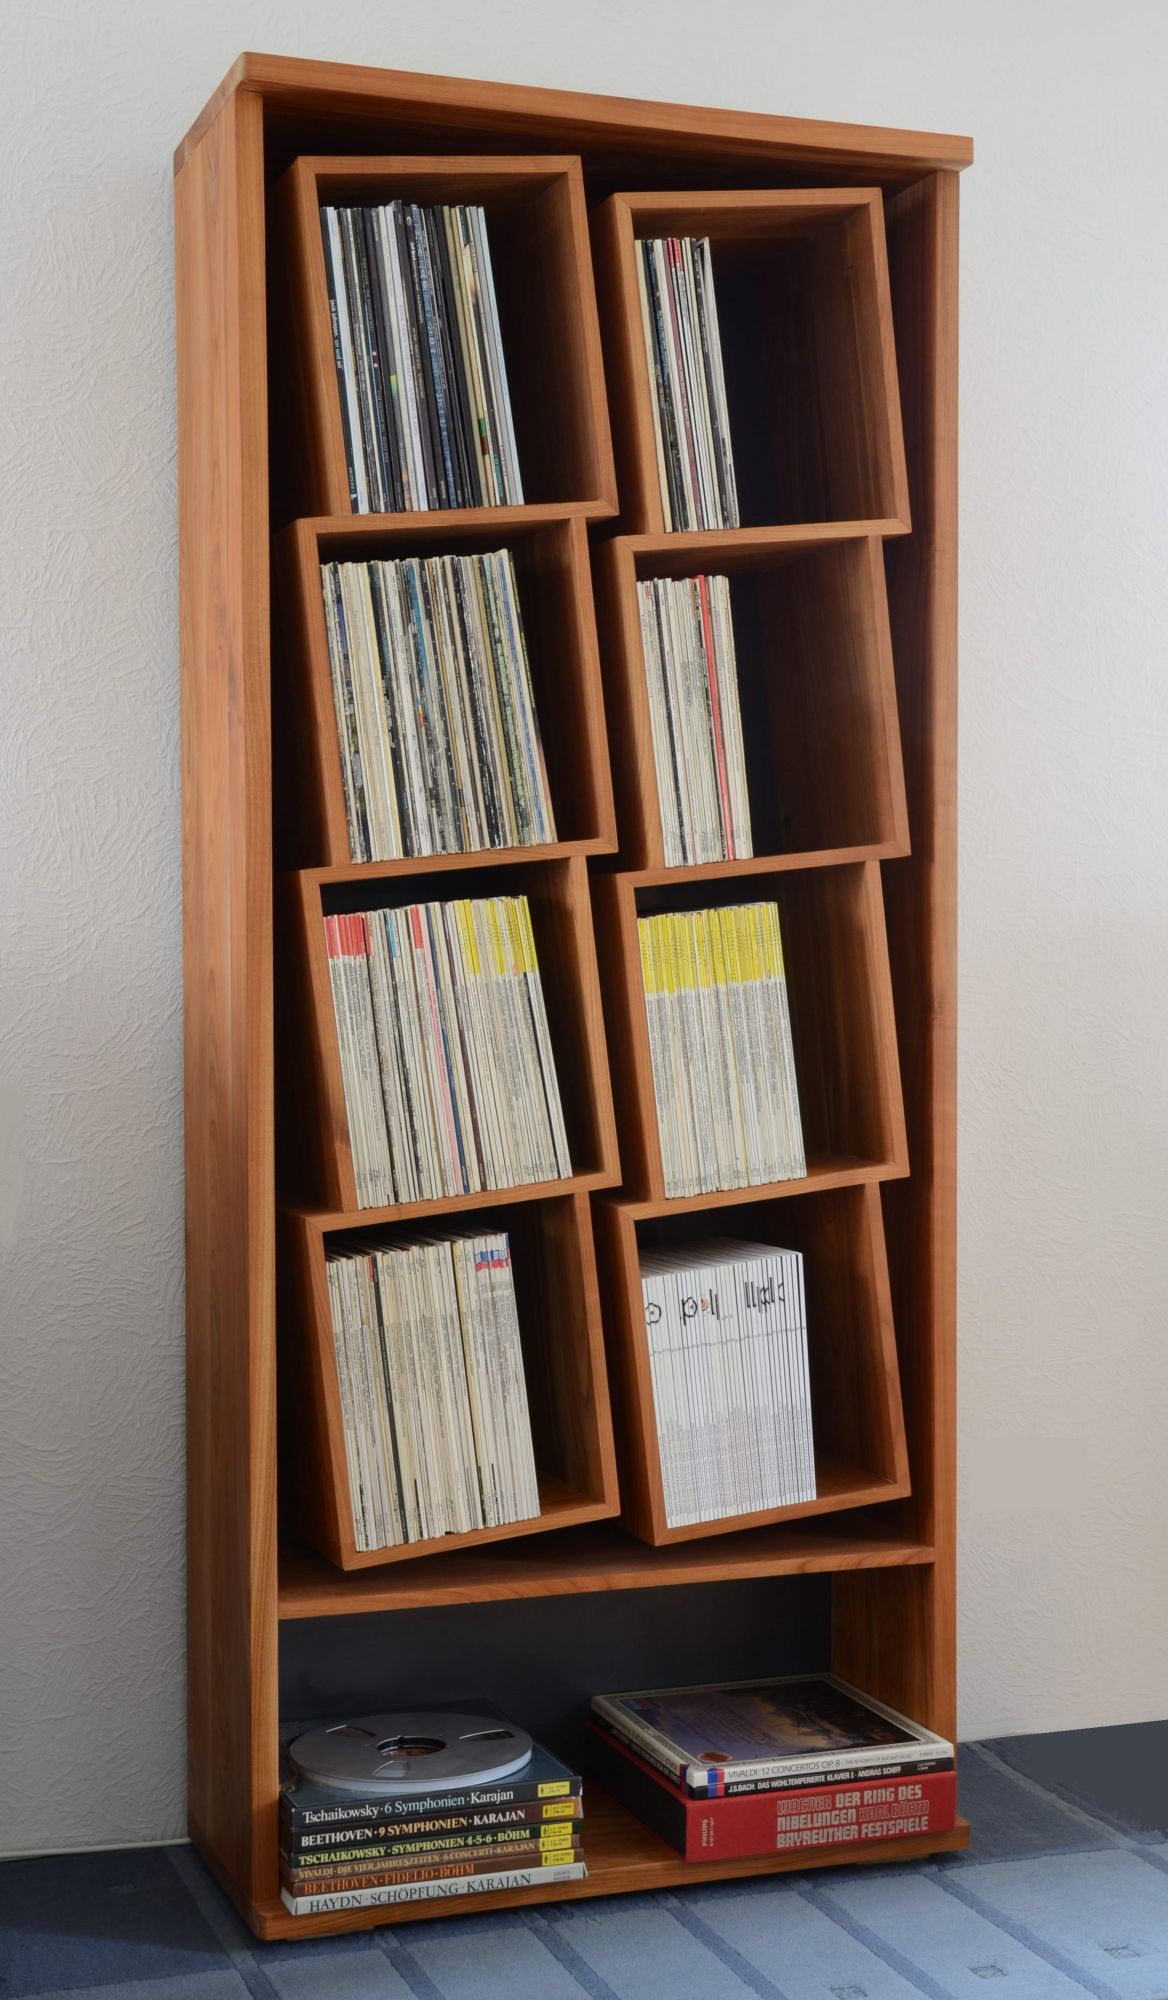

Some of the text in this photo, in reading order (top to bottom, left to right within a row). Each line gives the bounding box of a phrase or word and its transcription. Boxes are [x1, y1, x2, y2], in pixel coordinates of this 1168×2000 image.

[728, 1769, 759, 1779] VIVALDI:
[761, 1767, 770, 1775] 12
[772, 1762, 820, 1774] CONCERTOS
[757, 1781, 770, 1790] DAS
[771, 1774, 825, 1788] WOHLTEMPERIERTE
[827, 1771, 850, 1781] KLAVIER
[883, 1766, 901, 1775] SCHIFF
[302, 1789, 514, 1824] Tschaikowsky 6 Symphonien Karajan
[777, 1784, 922, 1815] WAGNER DER RING DES
[301, 1809, 525, 1847] BEETHOVEN 9 SYMPHONIEN KARAJAN
[776, 1815, 928, 1849] BAYREUTHER FESTSPIELE
[777, 1808, 856, 1831] NIBELUNGEN
[299, 1846, 387, 1866] TSCHAIKOWSKY
[391, 1837, 465, 1855] SYMPHONIEN
[497, 1829, 530, 1841] BÖHM
[299, 1867, 334, 1879] VIVALDI
[337, 1864, 353, 1875] DIE
[449, 1847, 494, 1860] CONCERTI
[496, 1842, 535, 1855] KARAJAN
[304, 1863, 475, 1895] BEETHOVEN FIDELIO BÖHM
[310, 1894, 362, 1912] HAYDN
[370, 1883, 459, 1904] SCHÖPFUNG
[466, 1873, 532, 1892] KARAJAN
